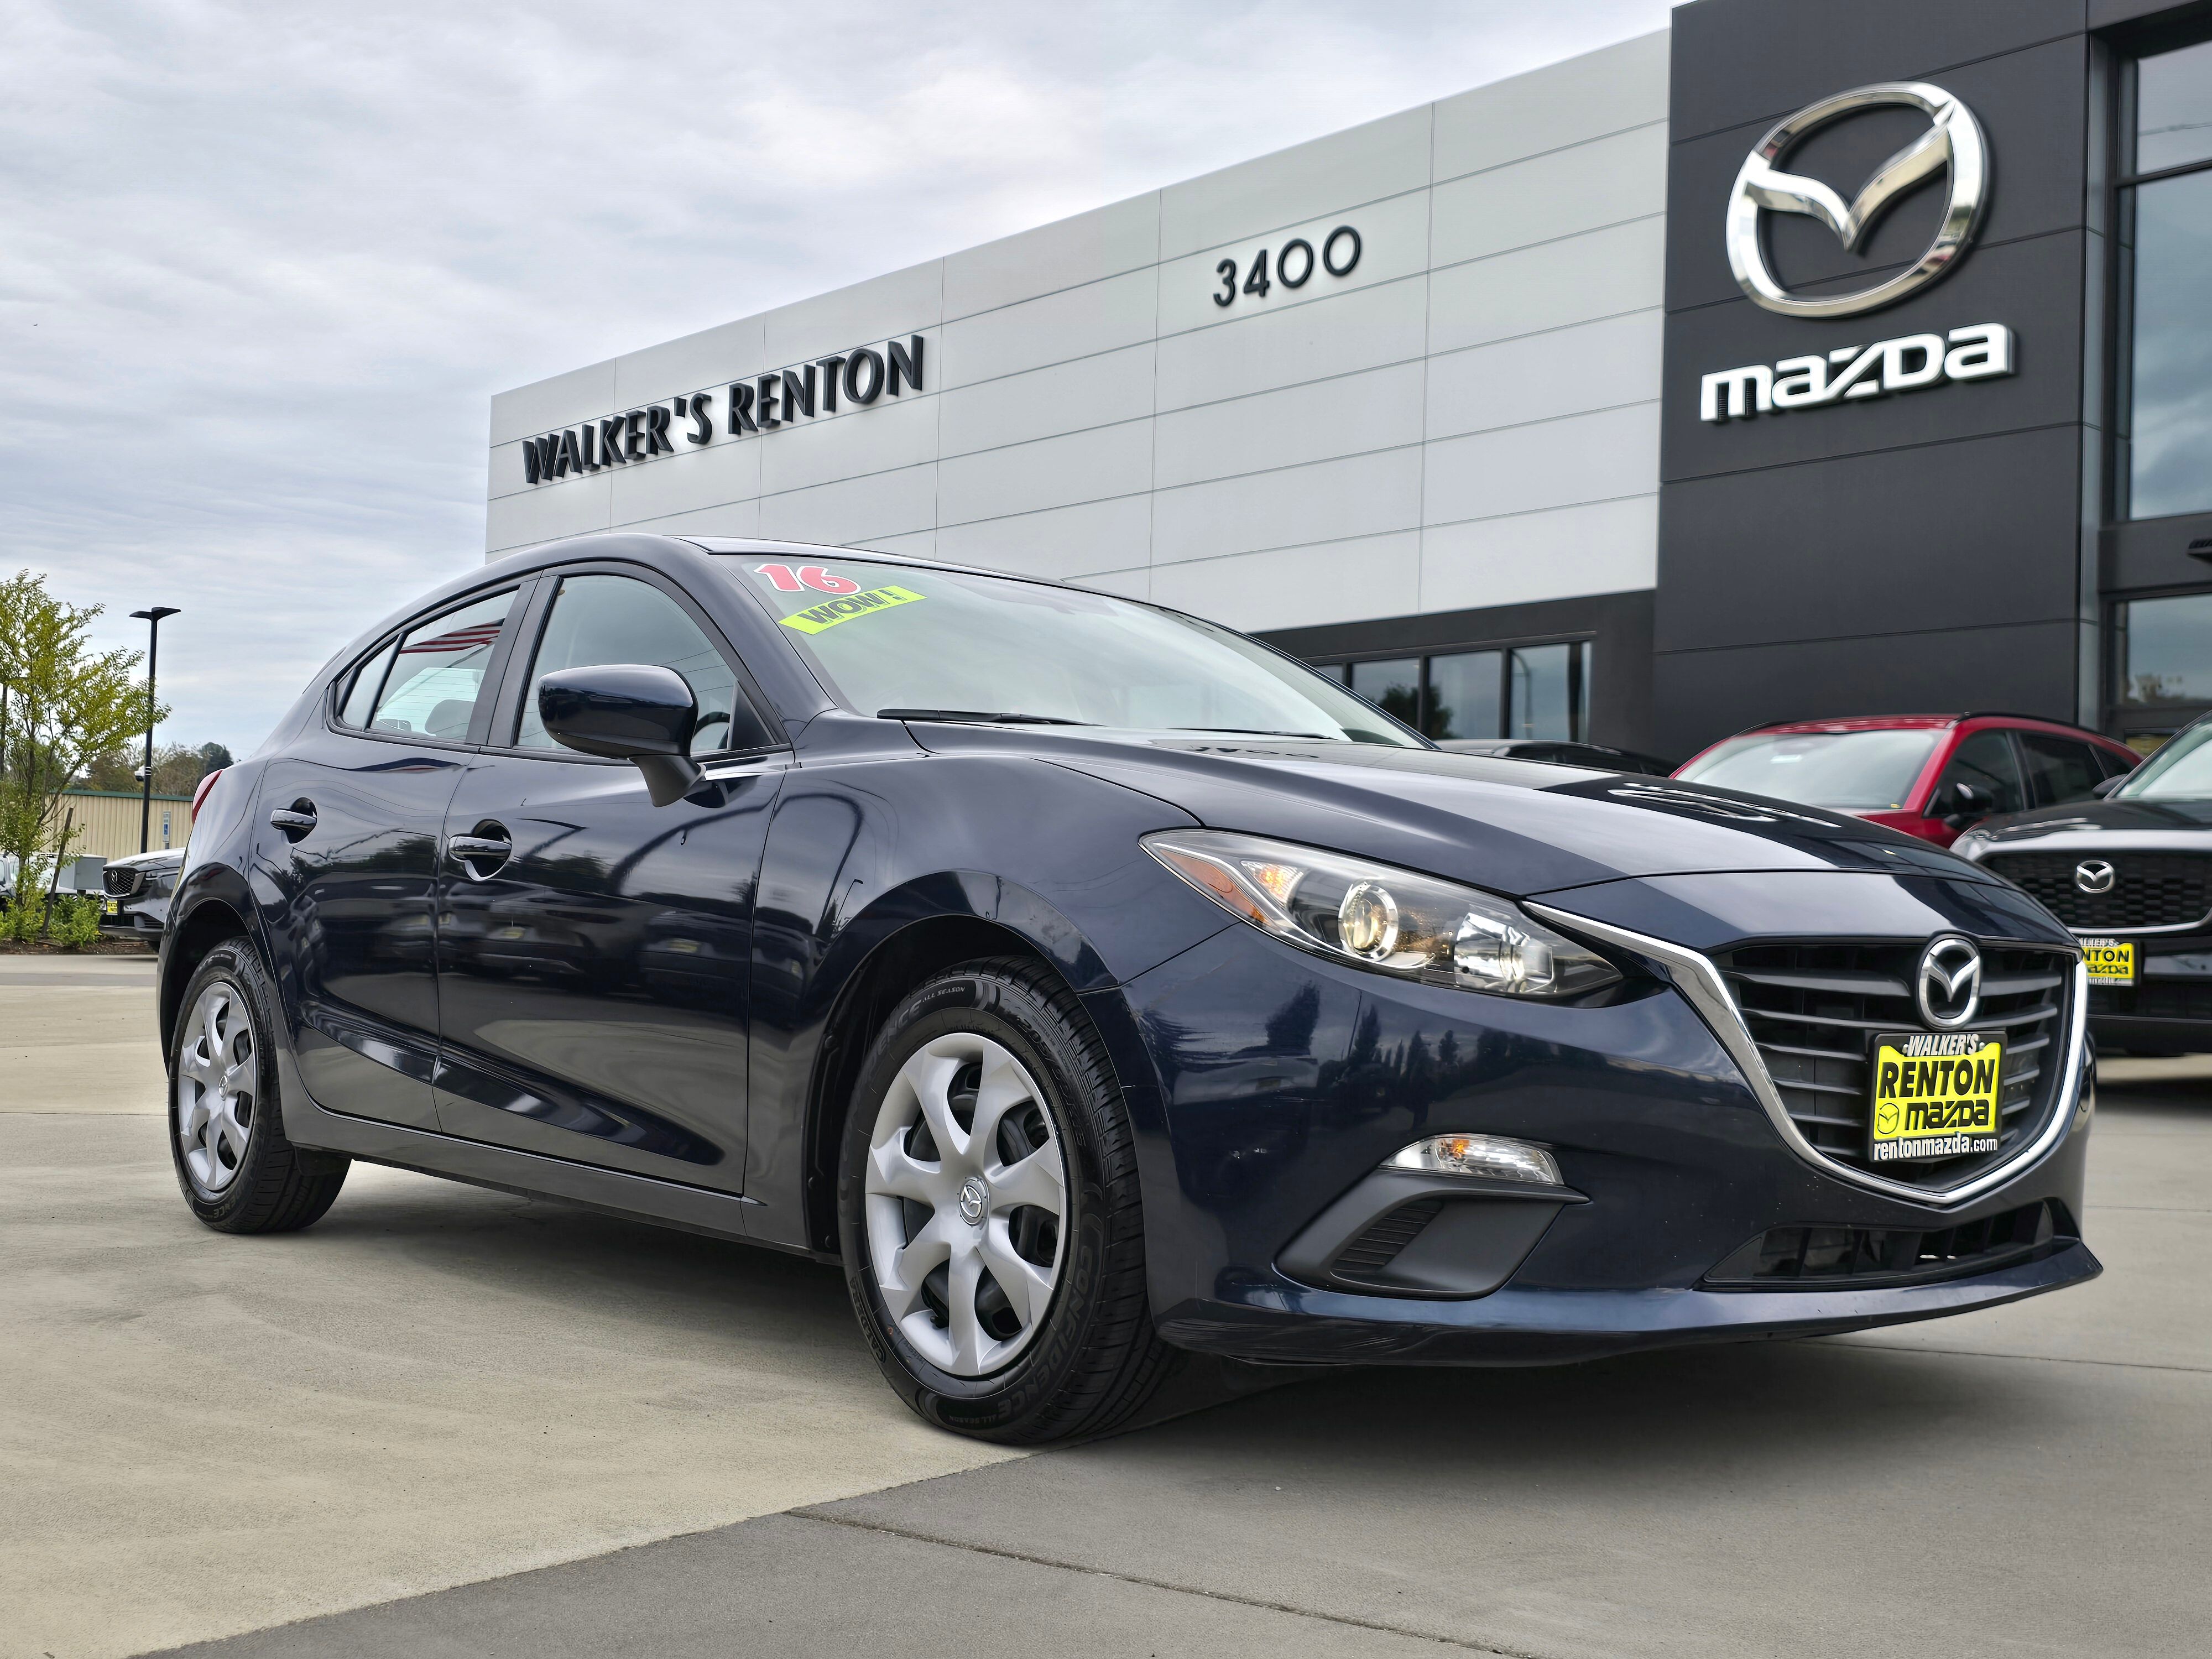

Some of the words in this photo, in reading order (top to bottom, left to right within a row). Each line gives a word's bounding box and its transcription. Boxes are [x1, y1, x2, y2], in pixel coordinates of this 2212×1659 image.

[1213, 225, 1361, 306] 3400
[523, 393, 711, 484] WALKER'S
[728, 335, 924, 435] RENTON
[753, 564, 861, 594] 16
[2084, 950, 2129, 962] NTON
[1907, 1034, 1979, 1056] WALKER'S
[1879, 1059, 1995, 1098] RENTON
[1874, 1132, 1998, 1160] rentonmazda.com
[997, 1246, 1093, 1418] CONFIDENCE
